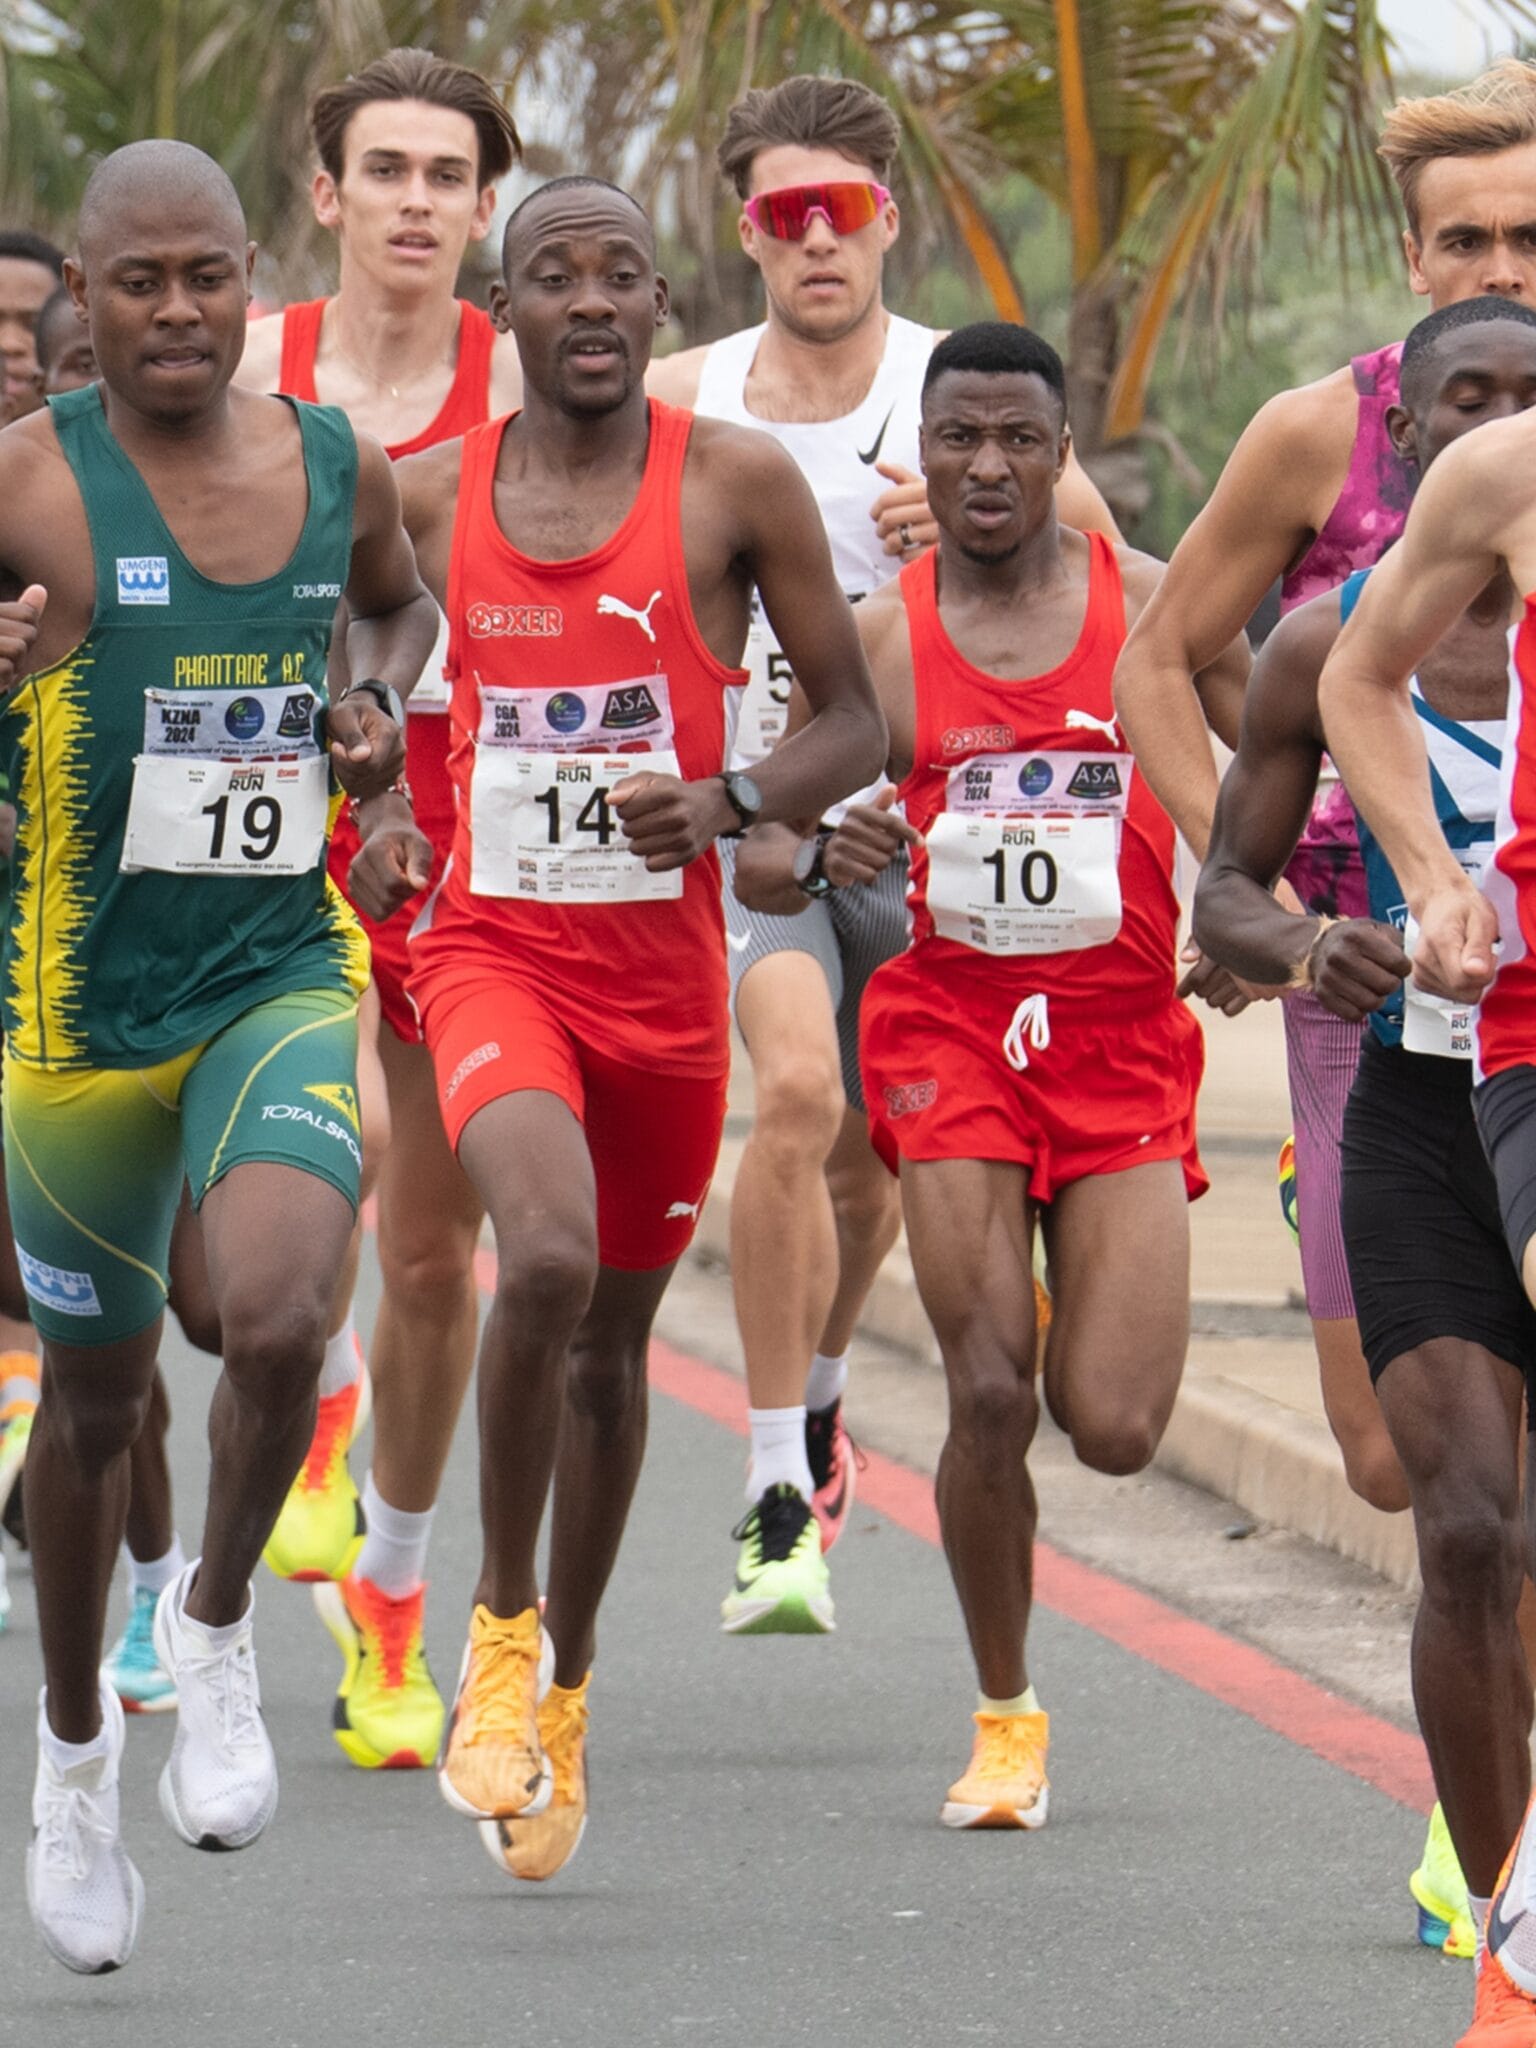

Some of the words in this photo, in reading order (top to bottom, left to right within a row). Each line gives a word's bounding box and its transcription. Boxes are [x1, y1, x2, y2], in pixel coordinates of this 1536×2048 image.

[118, 559, 167, 571] UMGENI
[292, 584, 342, 599] TOTALSPORTS
[466, 602, 563, 638] BOXER
[175, 653, 268, 687] PHANTANE
[283, 697, 312, 721] AS
[608, 690, 652, 714] ASA
[161, 709, 201, 725] KZNA
[495, 704, 519, 720] CGA
[164, 726, 196, 744] 2024
[494, 722, 520, 738] 2024
[941, 724, 1016, 756] BOXER
[228, 775, 264, 791] RUN
[556, 767, 591, 783] RUN
[965, 770, 992, 785] CGA
[1076, 765, 1117, 784] ASA
[964, 785, 990, 801] 2024
[534, 786, 616, 845] 14
[202, 795, 282, 861] 19
[1002, 830, 1035, 845] RUN
[983, 848, 1058, 906] 10
[1451, 1015, 1470, 1030] RU
[261, 1103, 362, 1175] TOTALSPO
